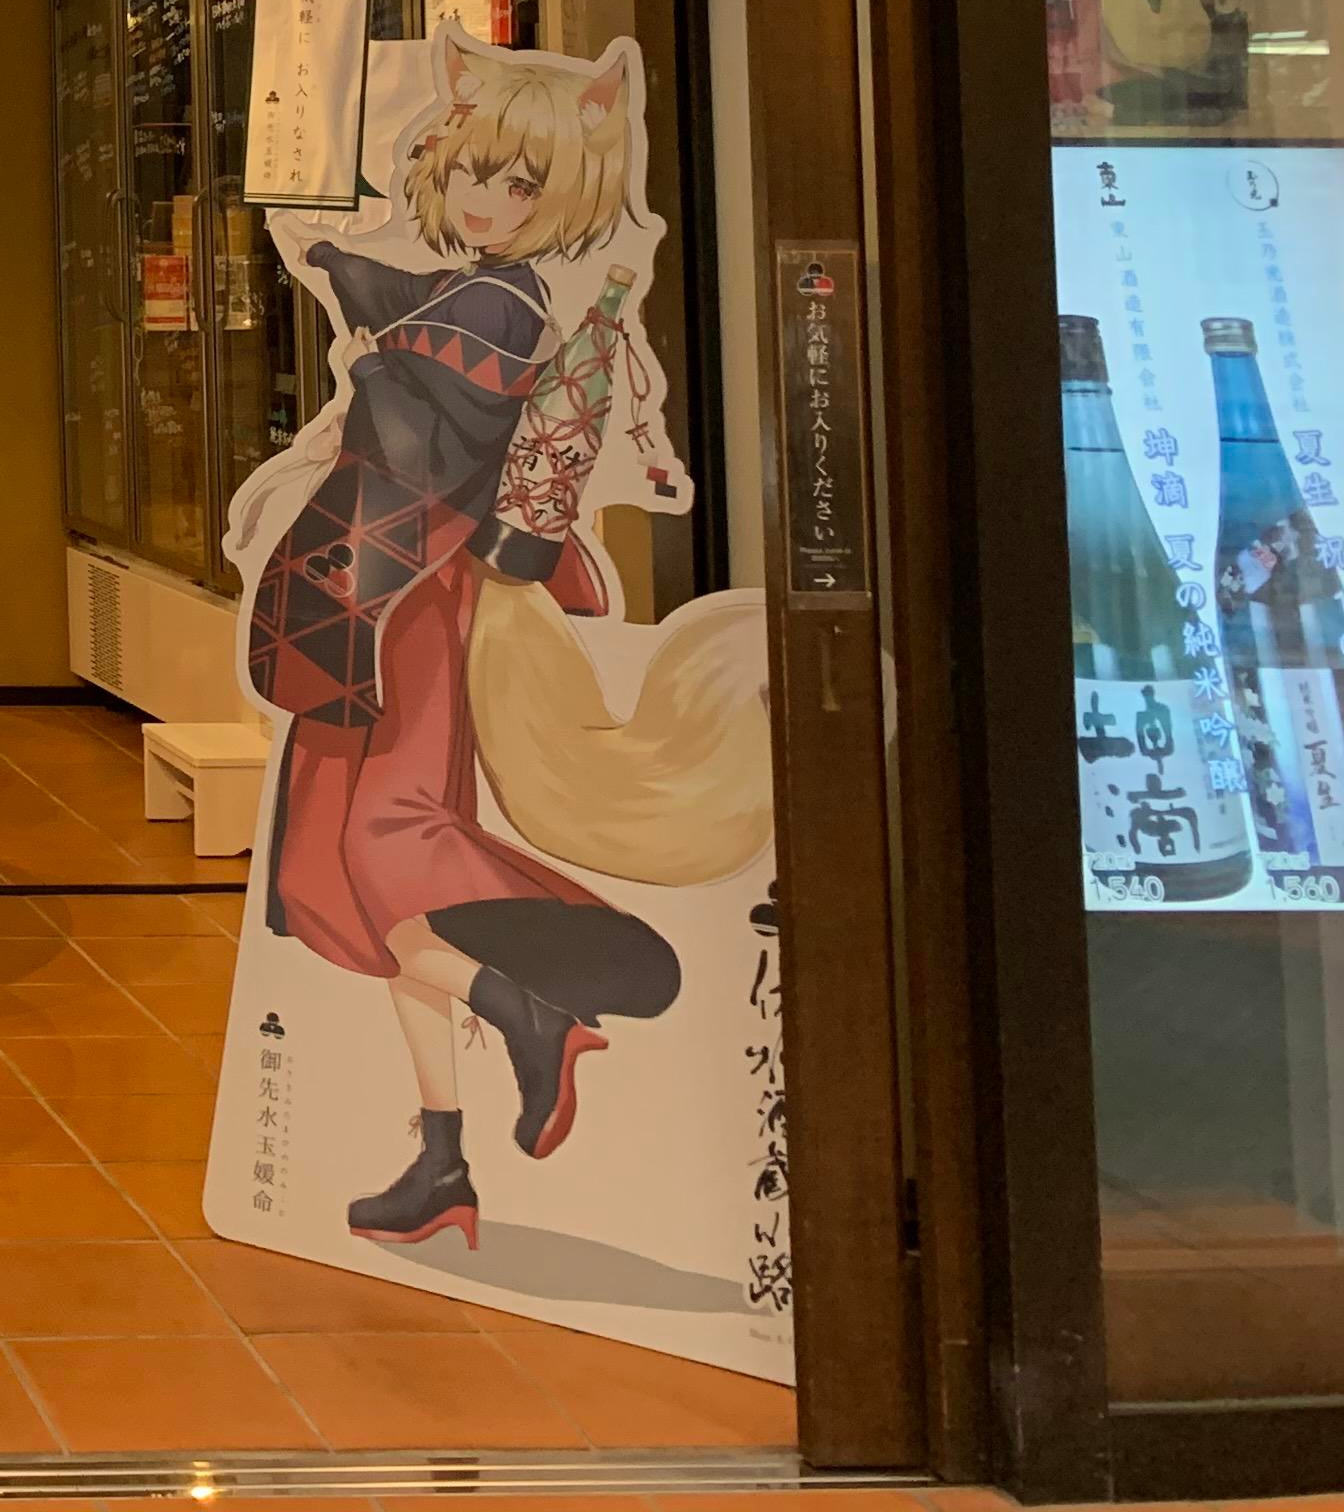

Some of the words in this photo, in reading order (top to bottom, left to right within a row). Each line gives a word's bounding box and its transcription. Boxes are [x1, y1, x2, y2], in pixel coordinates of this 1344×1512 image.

[806, 301, 835, 542] お気軽にお入りください
[253, 1048, 282, 1213] 御先水玉媛命
